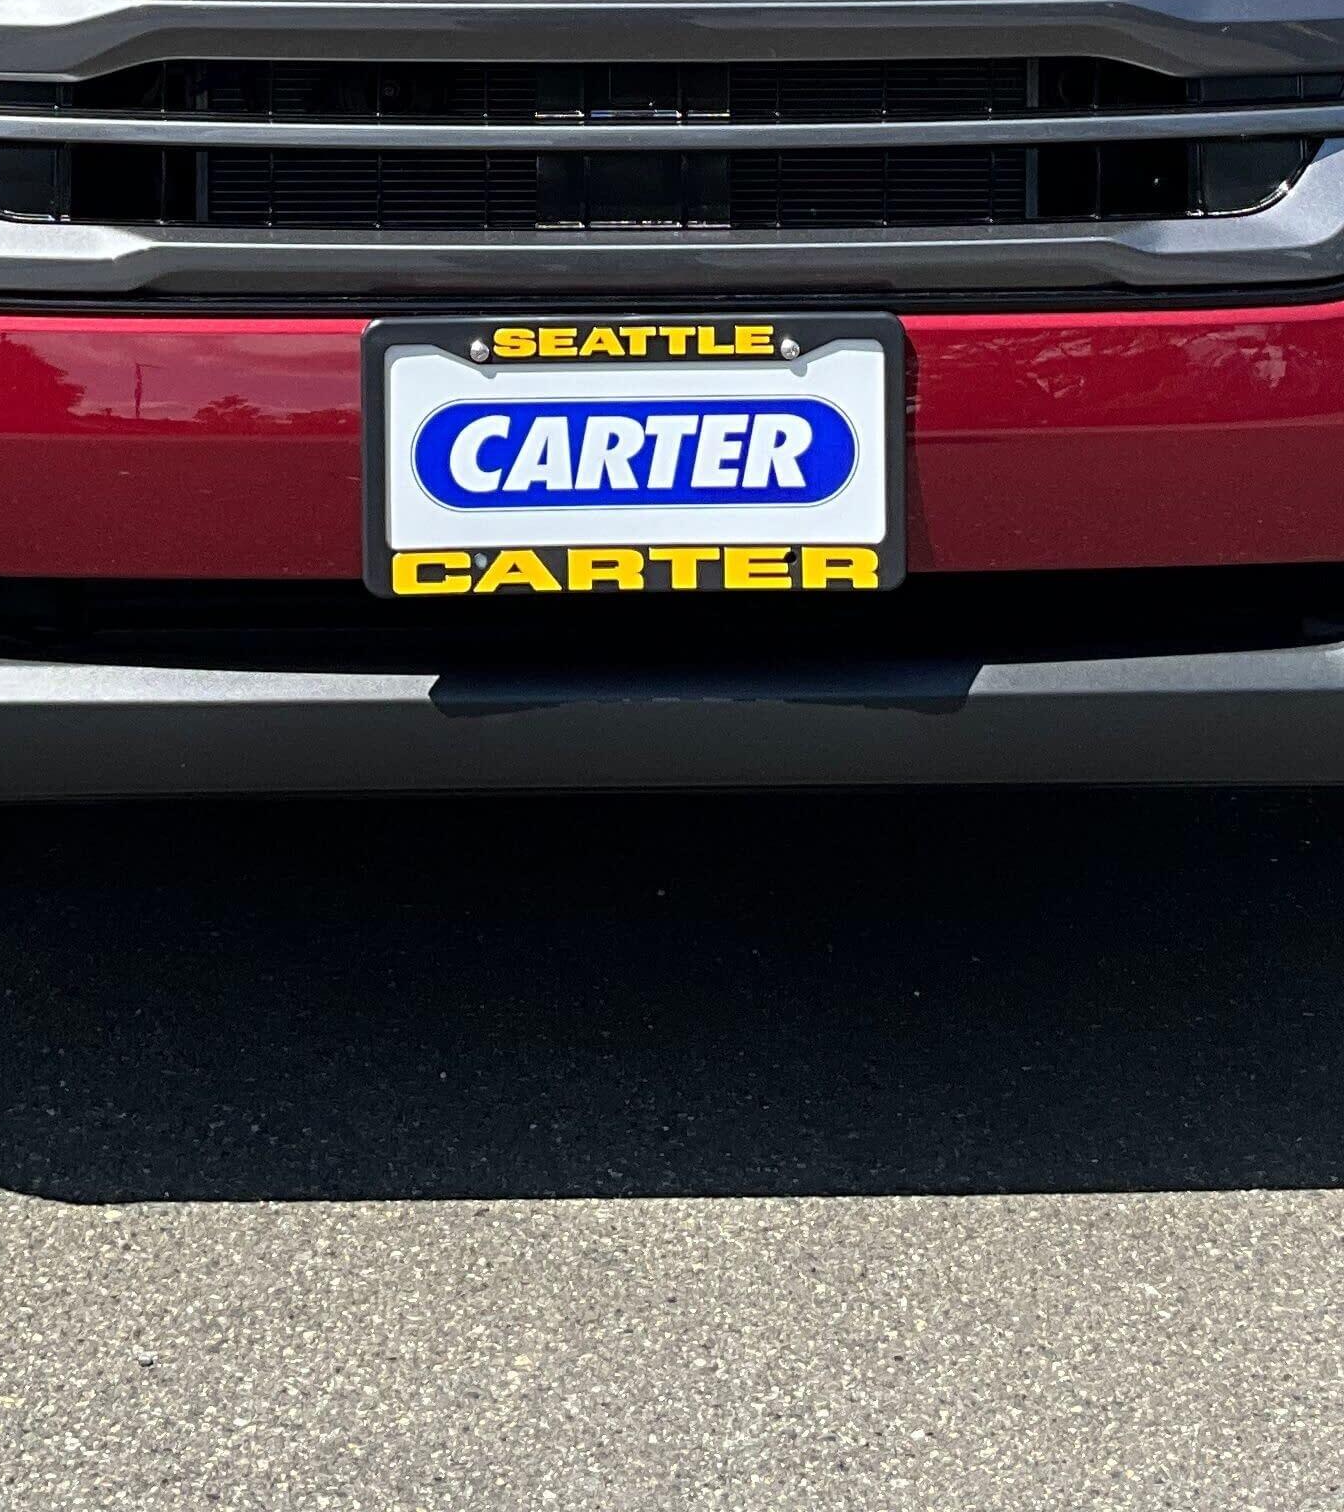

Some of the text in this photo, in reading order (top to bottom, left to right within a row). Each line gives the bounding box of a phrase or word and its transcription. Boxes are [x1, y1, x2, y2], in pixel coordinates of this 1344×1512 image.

[492, 325, 775, 358] SEATTLE
[448, 413, 813, 494] CARTER
[390, 546, 880, 596] CARTER
